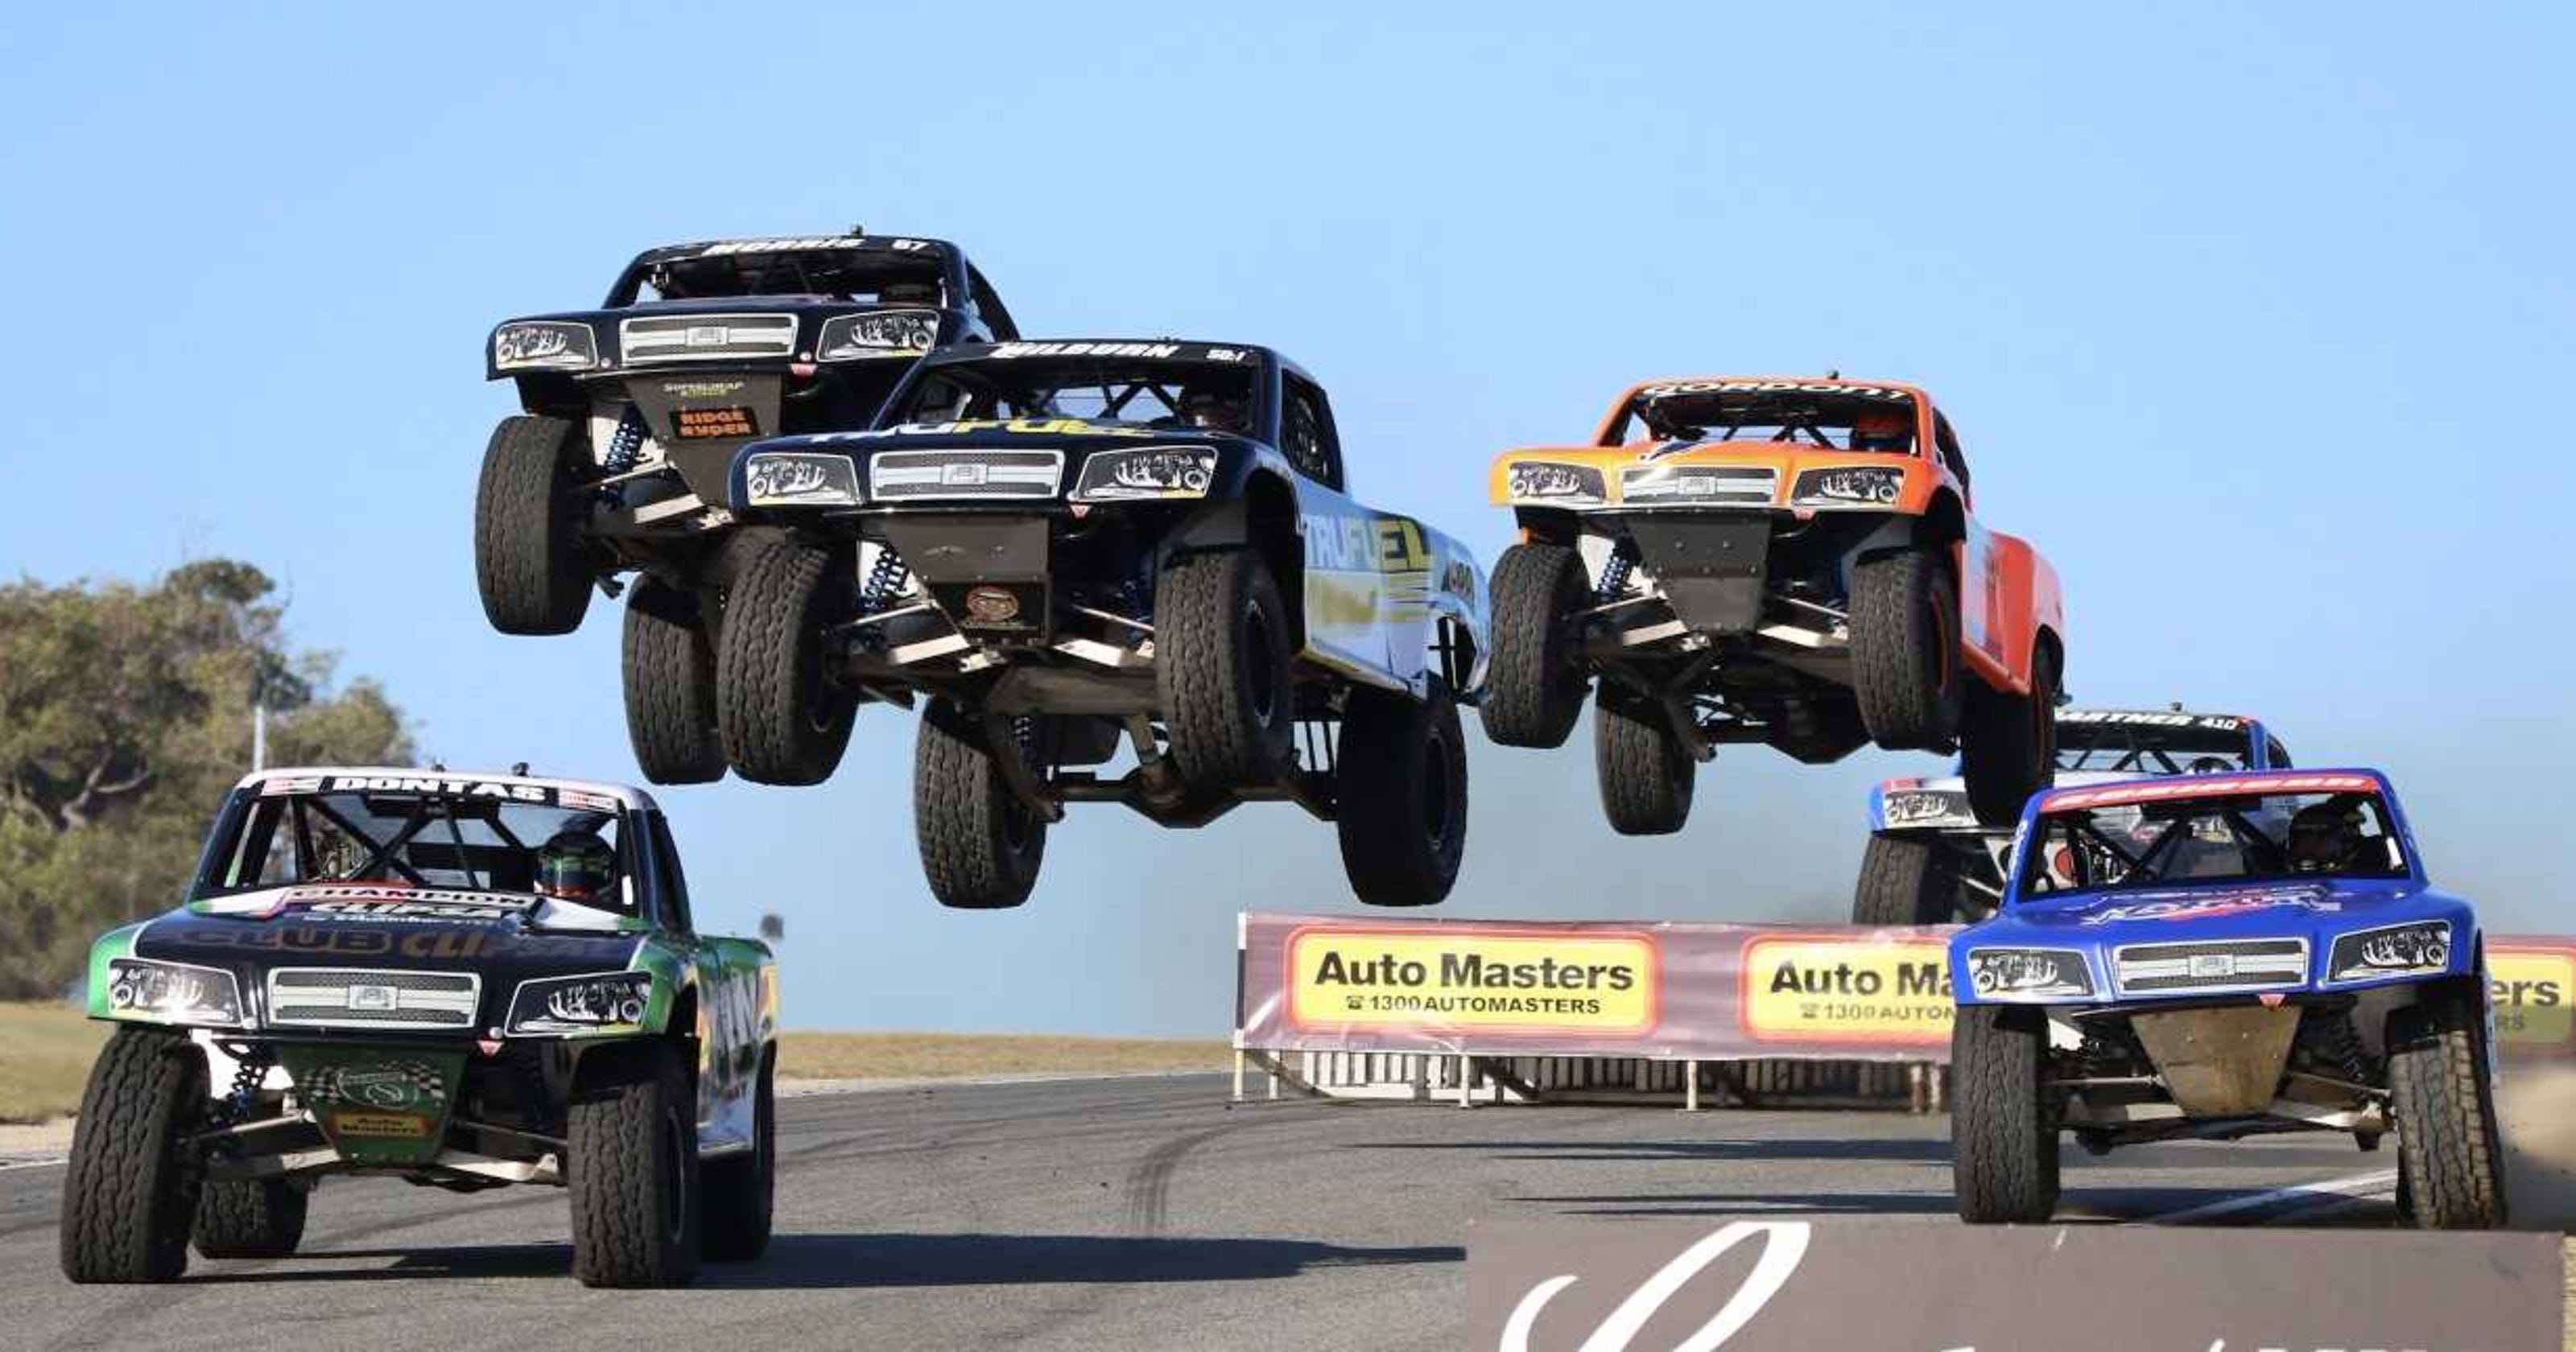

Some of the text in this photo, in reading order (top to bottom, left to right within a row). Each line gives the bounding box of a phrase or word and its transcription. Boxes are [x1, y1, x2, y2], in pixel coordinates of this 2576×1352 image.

[680, 410, 746, 424] RIDGE
[680, 422, 752, 437] RYDER
[332, 776, 546, 802] DONTAS
[293, 887, 527, 906] CHAMPION
[1315, 951, 1634, 991] Auto Masters
[1771, 958, 1882, 995] Auto
